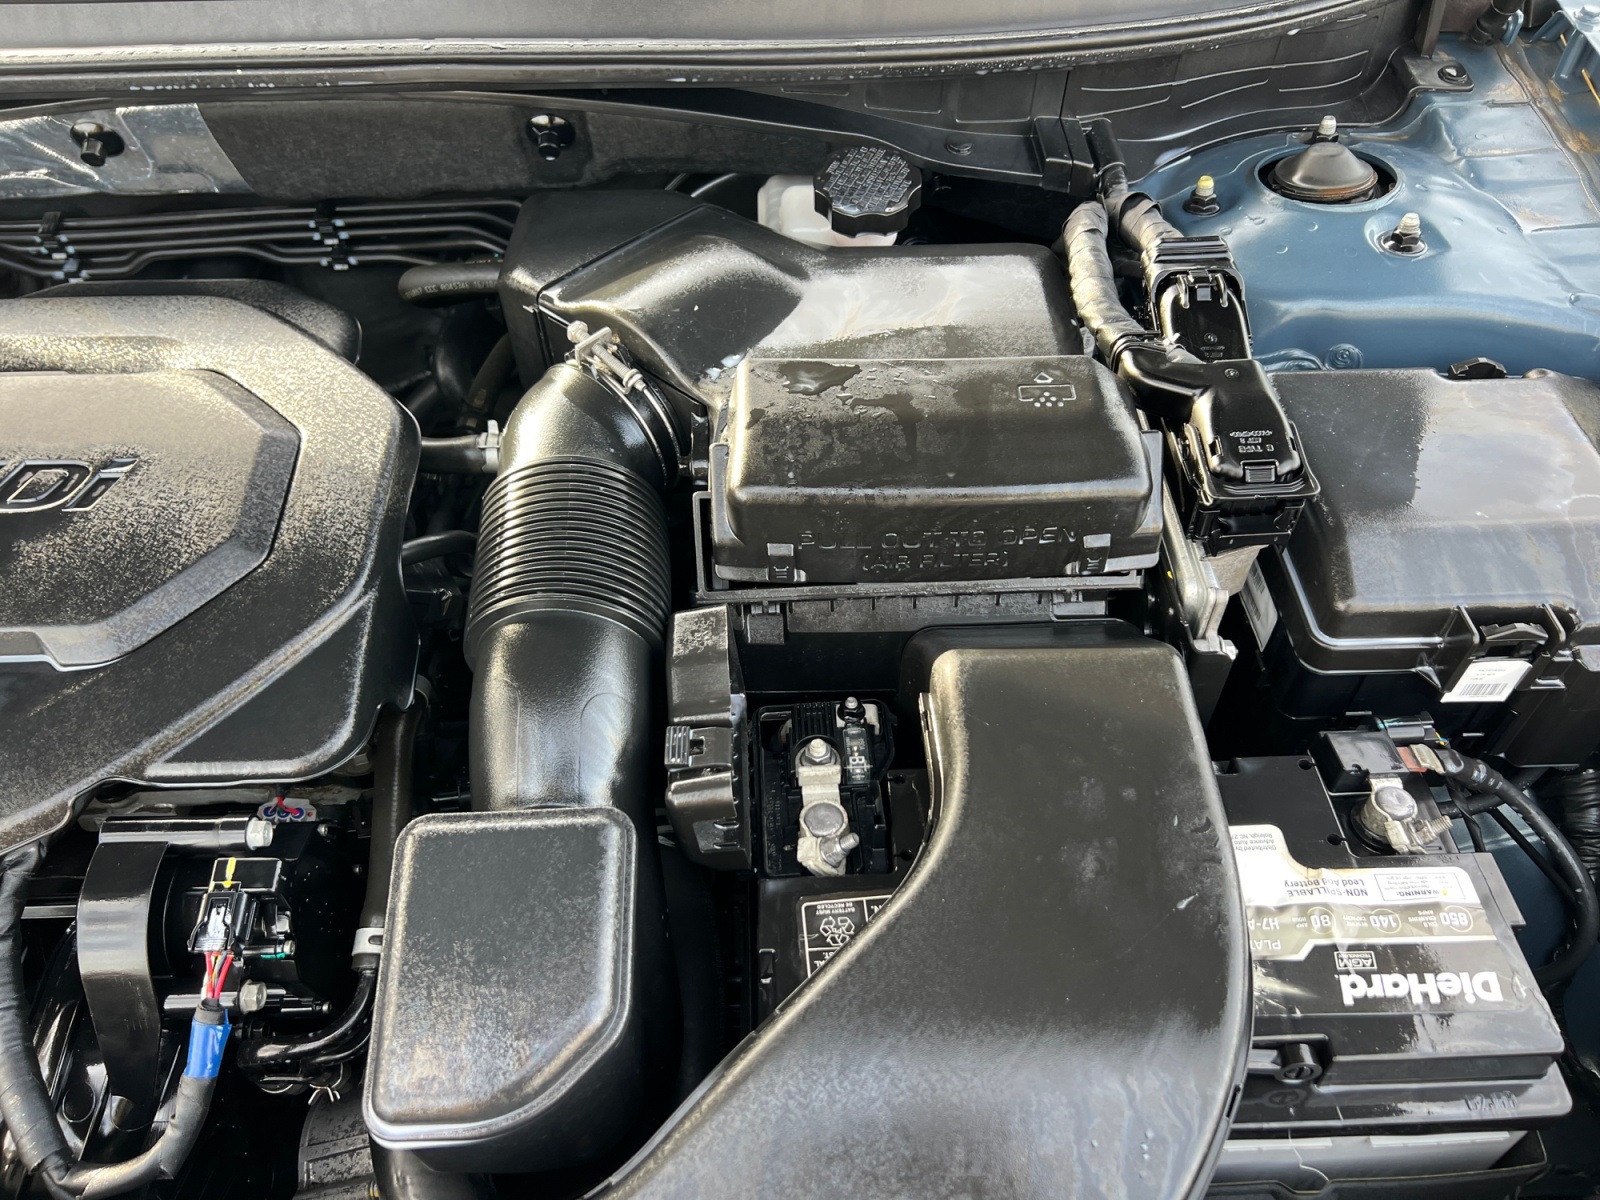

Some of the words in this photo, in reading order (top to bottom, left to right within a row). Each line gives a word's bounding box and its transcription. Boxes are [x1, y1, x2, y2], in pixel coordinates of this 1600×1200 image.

[0, 457, 140, 513] Di
[798, 530, 872, 549] PULL
[881, 531, 943, 549] OUT
[949, 530, 987, 546] TO
[1002, 526, 1077, 545] OPEN
[1284, 879, 1320, 888] Battery
[1341, 878, 1365, 887] Lead
[1286, 886, 1368, 898] NON-SPILLABLE
[1396, 888, 1440, 898] WARNING:
[1310, 914, 1332, 927] 80
[1369, 914, 1398, 929] 140
[1440, 911, 1469, 926] 850
[1338, 958, 1373, 968] AGM
[1338, 972, 1503, 1006] DieHard
